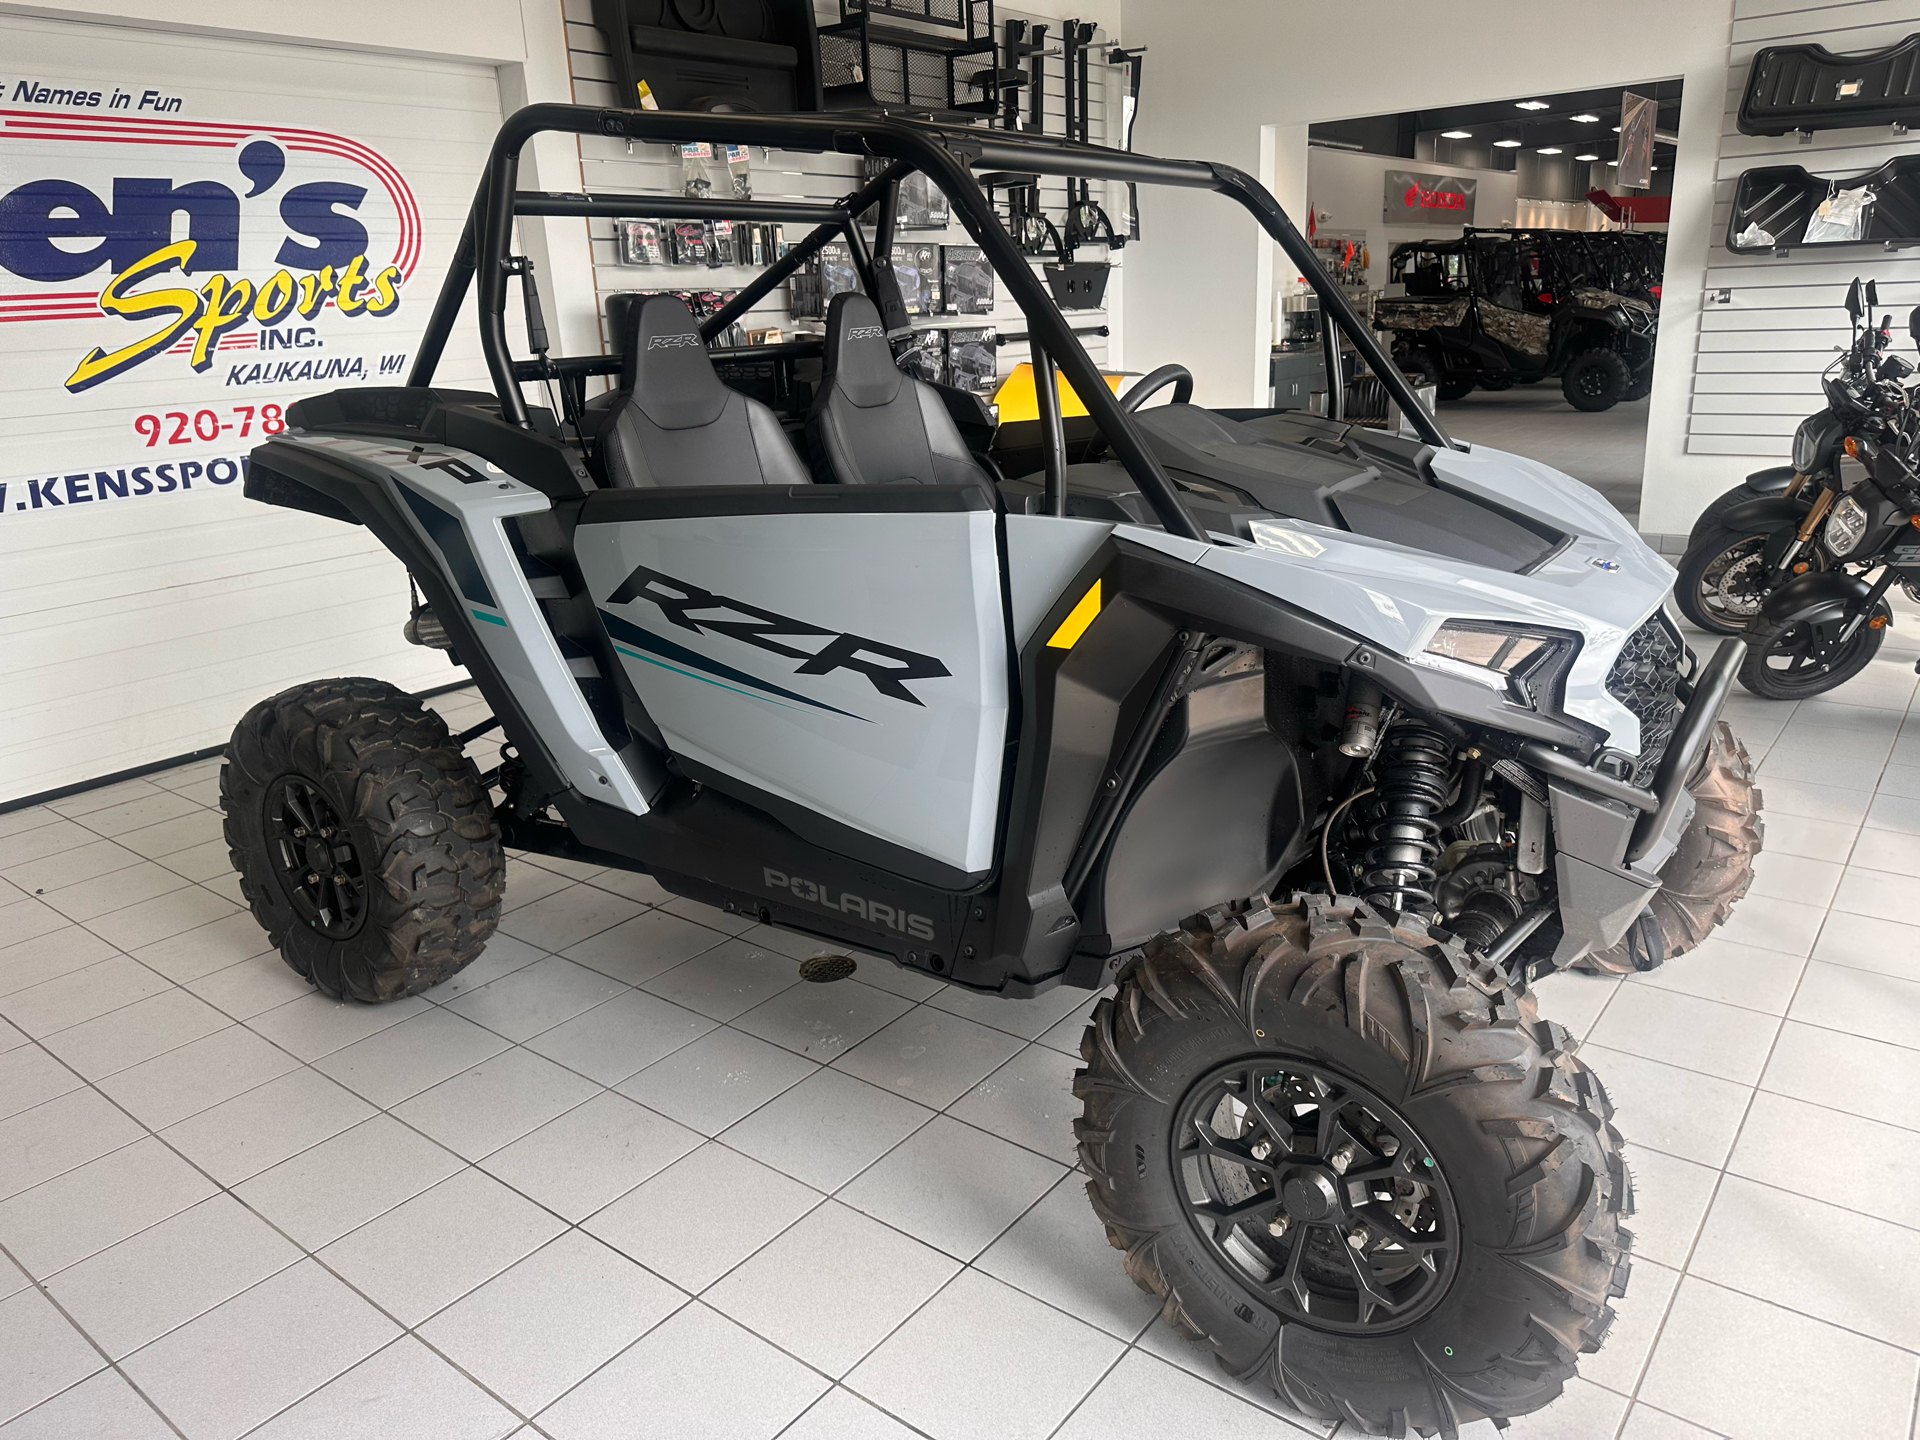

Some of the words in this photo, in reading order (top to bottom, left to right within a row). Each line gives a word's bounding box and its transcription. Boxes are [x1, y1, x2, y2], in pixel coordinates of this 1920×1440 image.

[12, 80, 102, 107] Names
[109, 88, 131, 109] in
[138, 90, 183, 112] Fun
[0, 140, 368, 282] en's
[1419, 189, 1466, 210] HONDA
[64, 240, 402, 394] Sports
[848, 326, 884, 340] RZR
[260, 327, 324, 351] INC.
[648, 333, 699, 350] RZR
[226, 364, 369, 387] KAUKAUNA,
[379, 354, 406, 375] WI
[134, 402, 297, 448] 920-78
[0, 455, 250, 513] .KENSSPO
[605, 564, 953, 709] RZR
[763, 866, 935, 942] POLARIS
